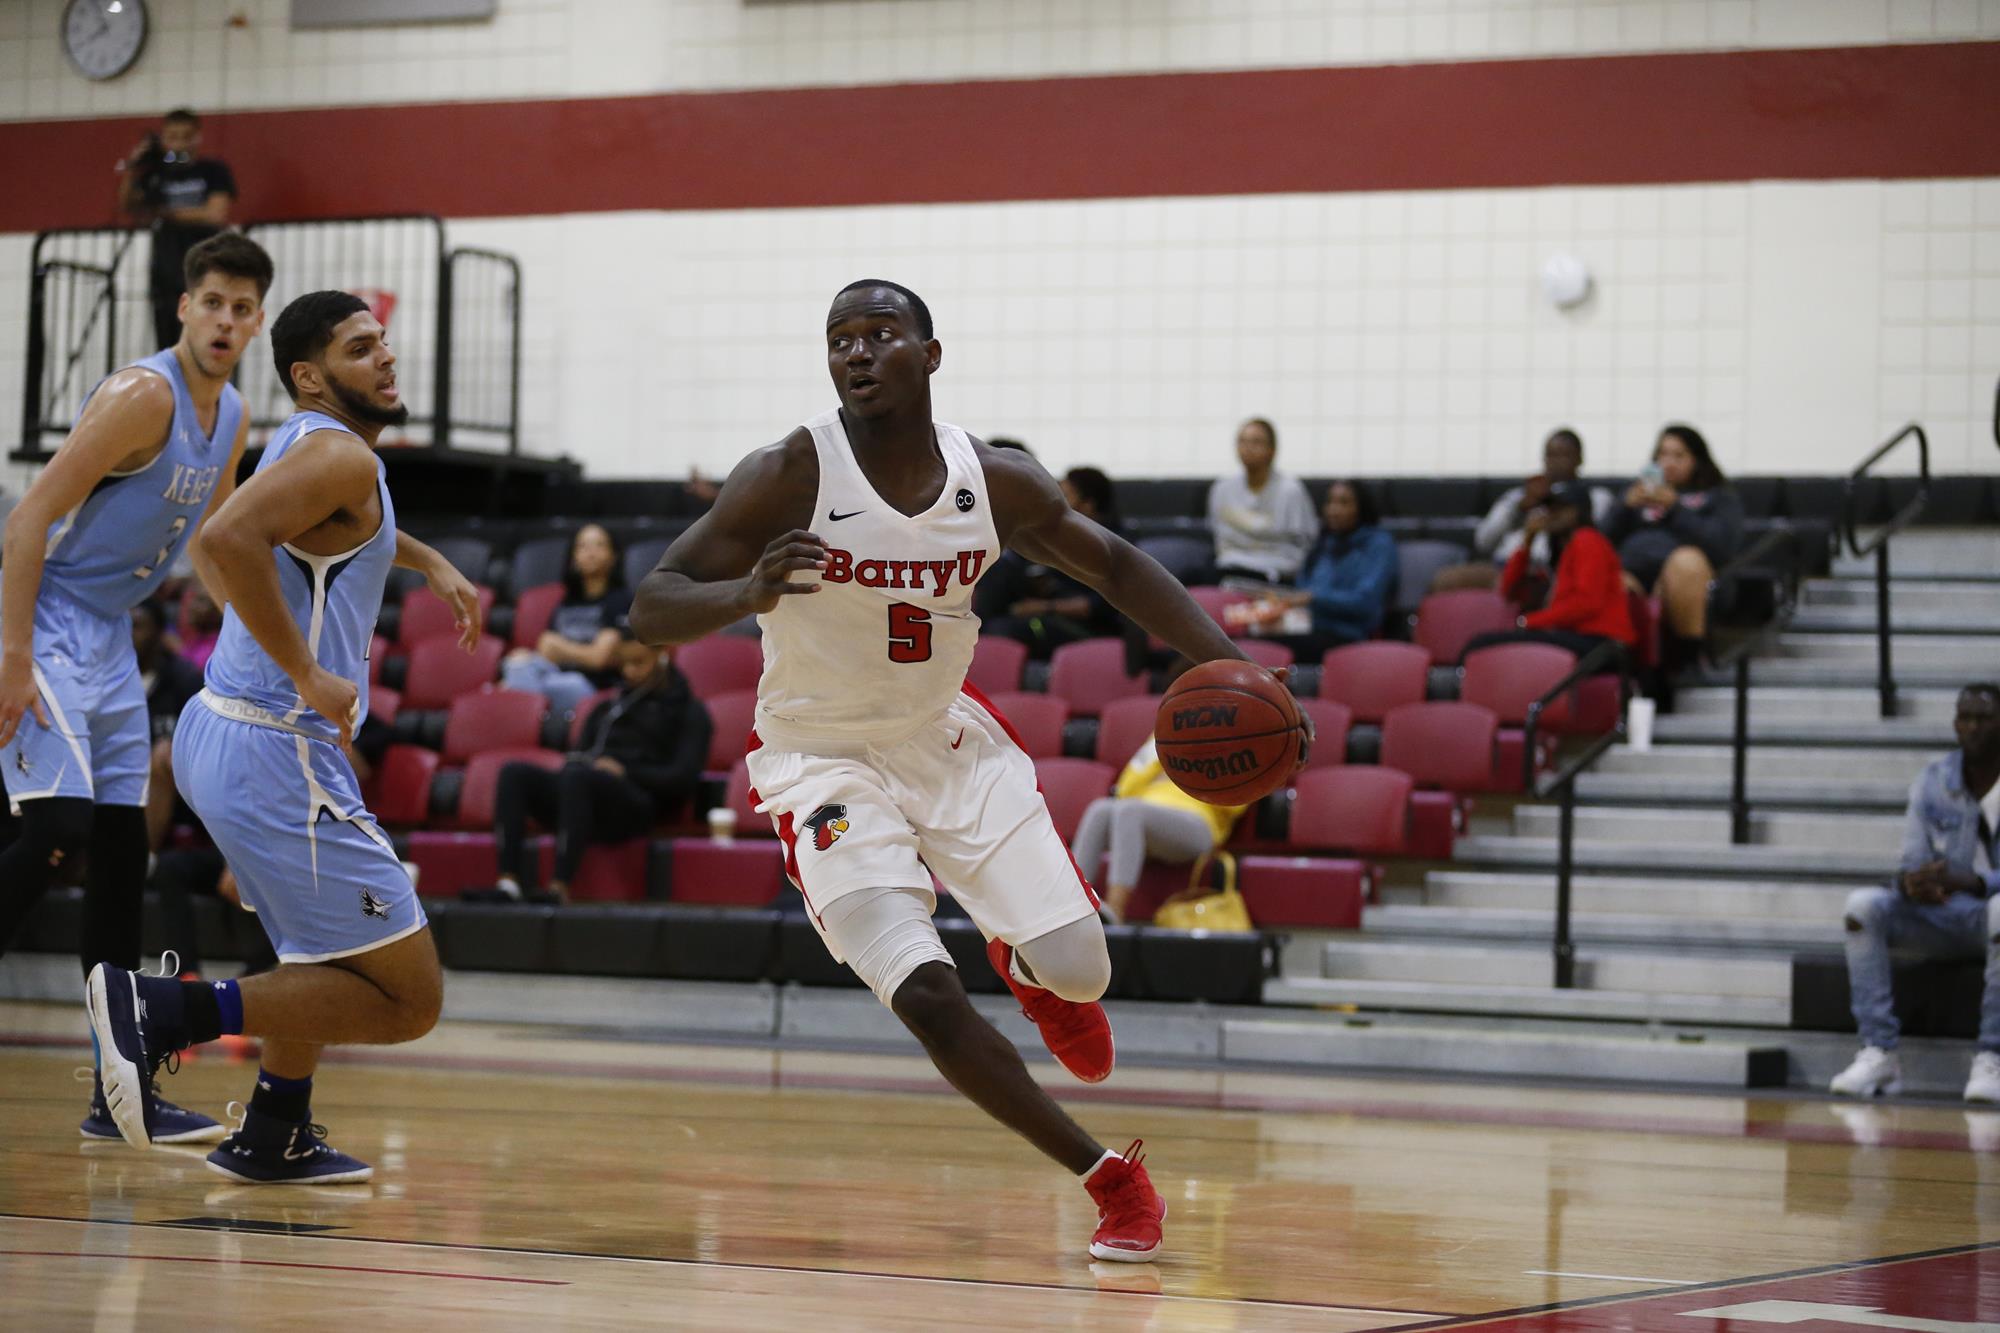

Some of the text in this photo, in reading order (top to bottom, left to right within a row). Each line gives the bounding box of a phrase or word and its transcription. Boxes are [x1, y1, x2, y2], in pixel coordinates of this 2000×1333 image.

[821, 548, 987, 598] BarryU
[887, 602, 933, 664] 5
[1172, 704, 1239, 732] NCAA
[1166, 747, 1260, 781] Wilson
